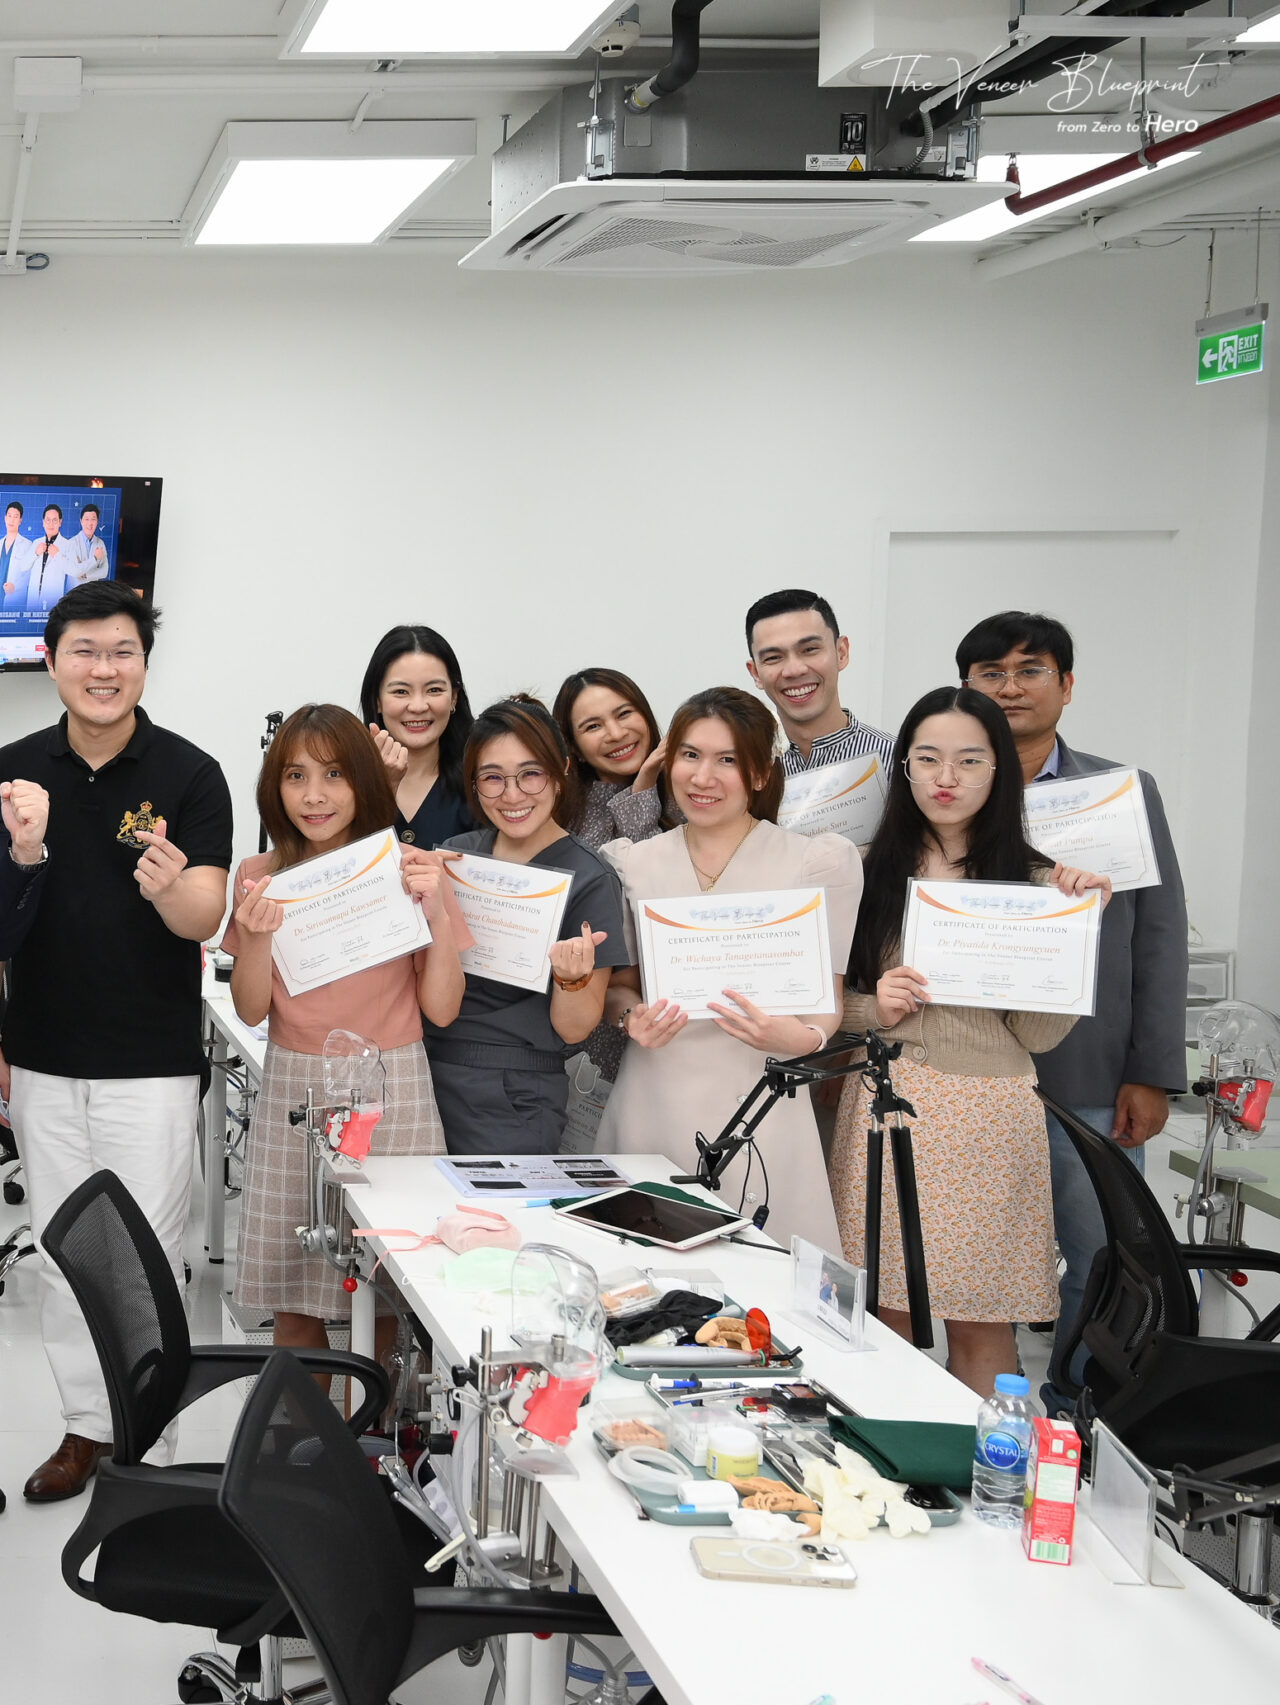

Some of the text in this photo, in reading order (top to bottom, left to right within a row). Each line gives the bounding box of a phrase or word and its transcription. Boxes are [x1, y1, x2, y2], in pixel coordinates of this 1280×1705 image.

[1238, 334, 1259, 350] EXIT
[811, 794, 867, 816] PARTICIPATION
[282, 900, 321, 920] ERTIFICATE
[321, 895, 332, 905] OF
[332, 874, 385, 900] PARTICIPATION
[483, 896, 493, 904] OF
[493, 898, 541, 915] PARTICIPATION
[292, 926, 304, 936] Dr.
[932, 920, 985, 929] CERTIFICATE
[1001, 924, 1068, 934] PARTICIPATION
[667, 934, 720, 945] CERTIFICATE
[735, 929, 801, 940] PARTICIPATION
[984, 1441, 1019, 1458] CRYSTAL
